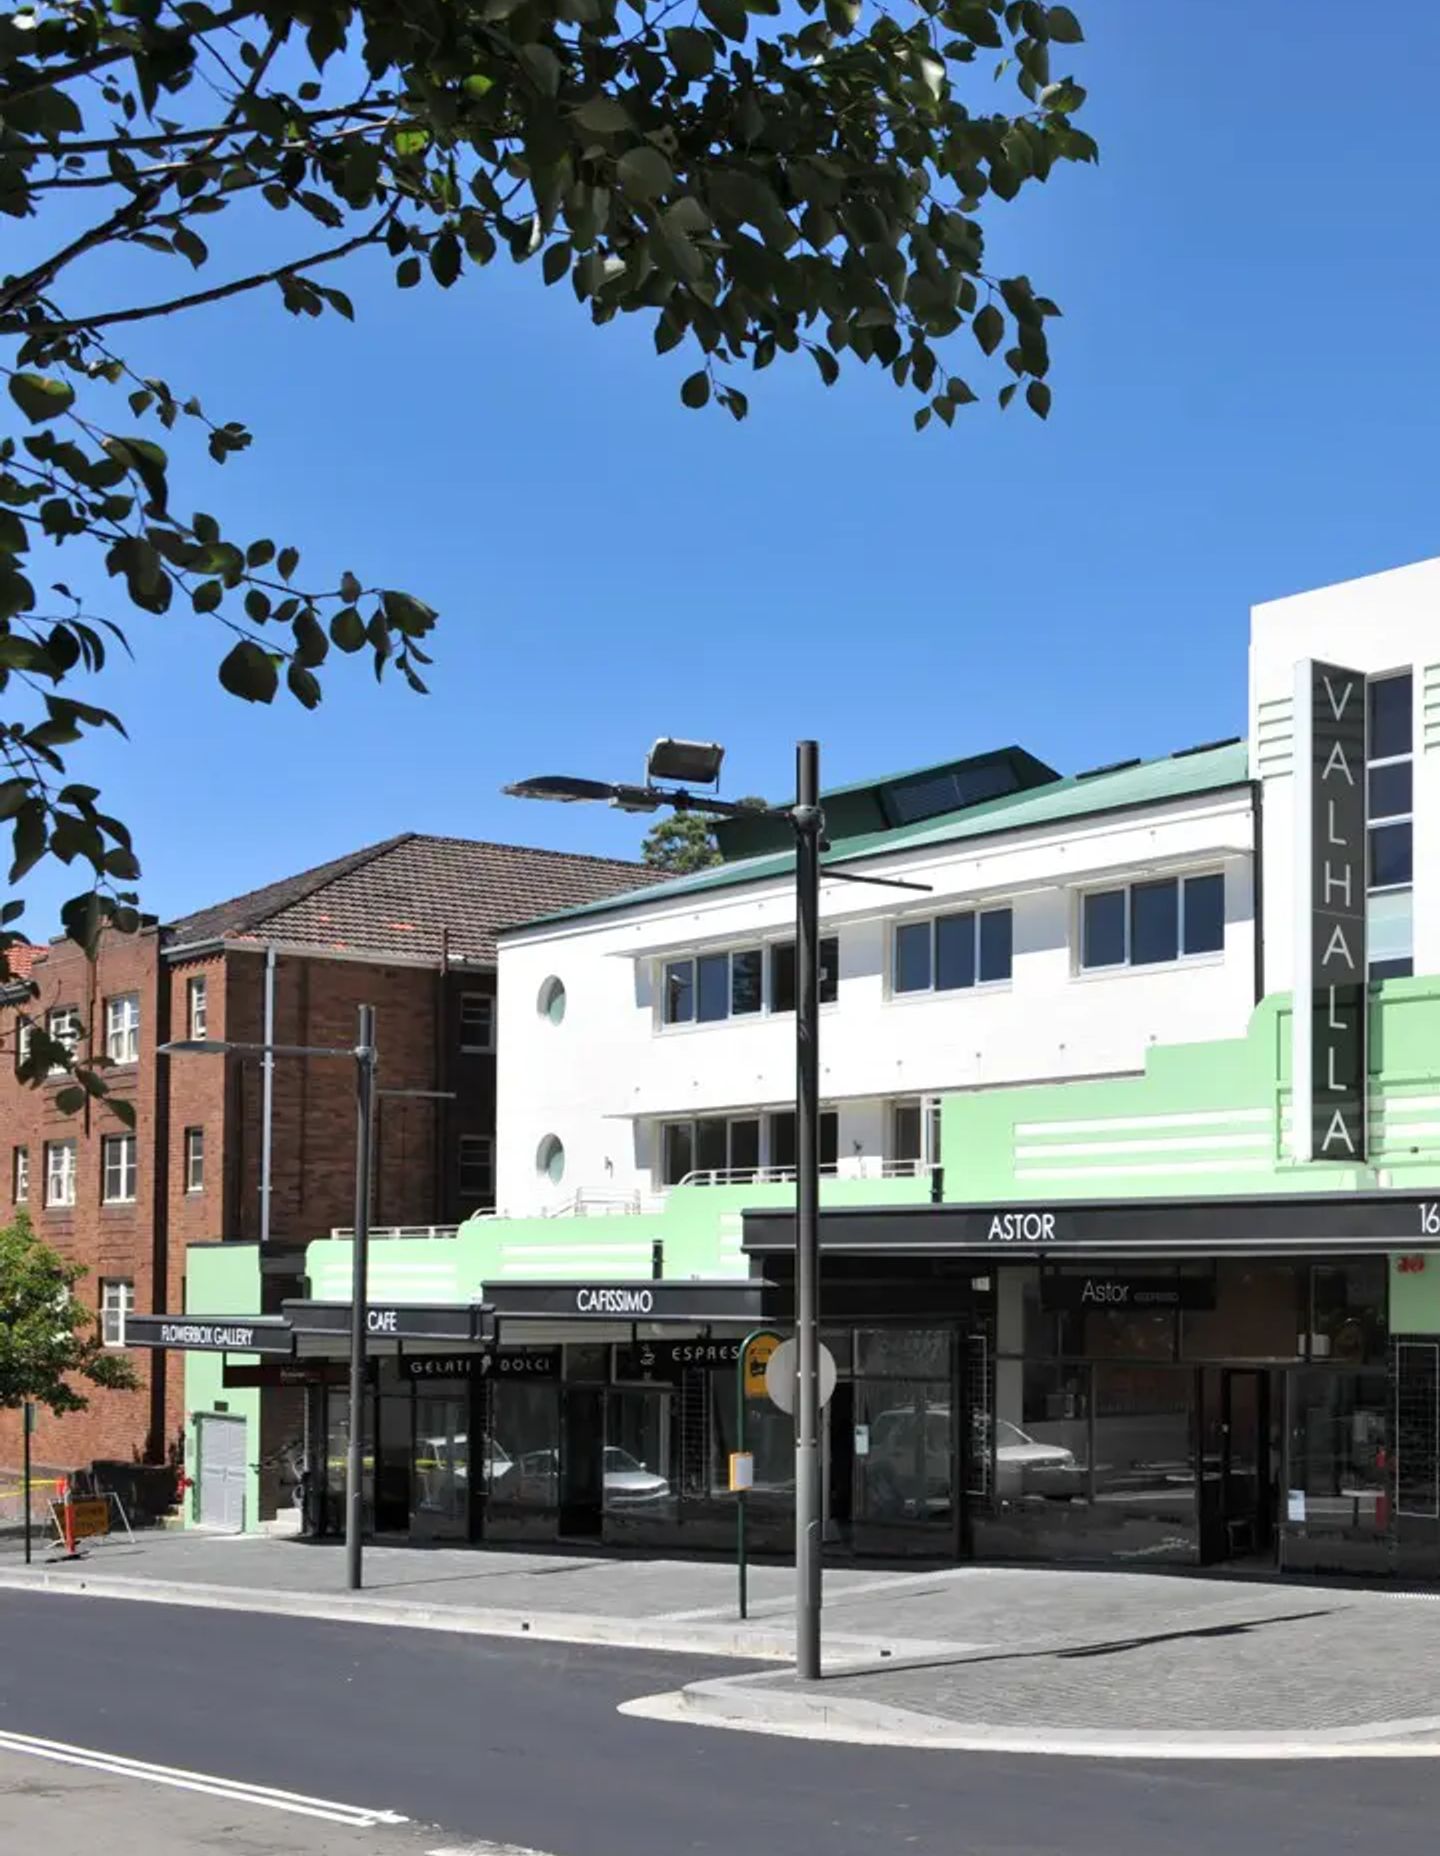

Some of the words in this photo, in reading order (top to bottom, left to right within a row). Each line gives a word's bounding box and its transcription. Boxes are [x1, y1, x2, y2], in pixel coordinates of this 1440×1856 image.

[1322, 676, 1355, 1155] VALHALLA
[987, 1213, 1056, 1241] ASTOR
[576, 1290, 653, 1313] CAFISSIMO
[1081, 1279, 1130, 1302] Astor
[367, 1311, 397, 1332] CAFE
[161, 1324, 212, 1344] FLOWERBOX
[214, 1327, 254, 1346] GALLERY
[671, 1345, 741, 1362] ESPRES
[410, 1360, 471, 1374] GELATI
[501, 1358, 550, 1372] DOLCI
